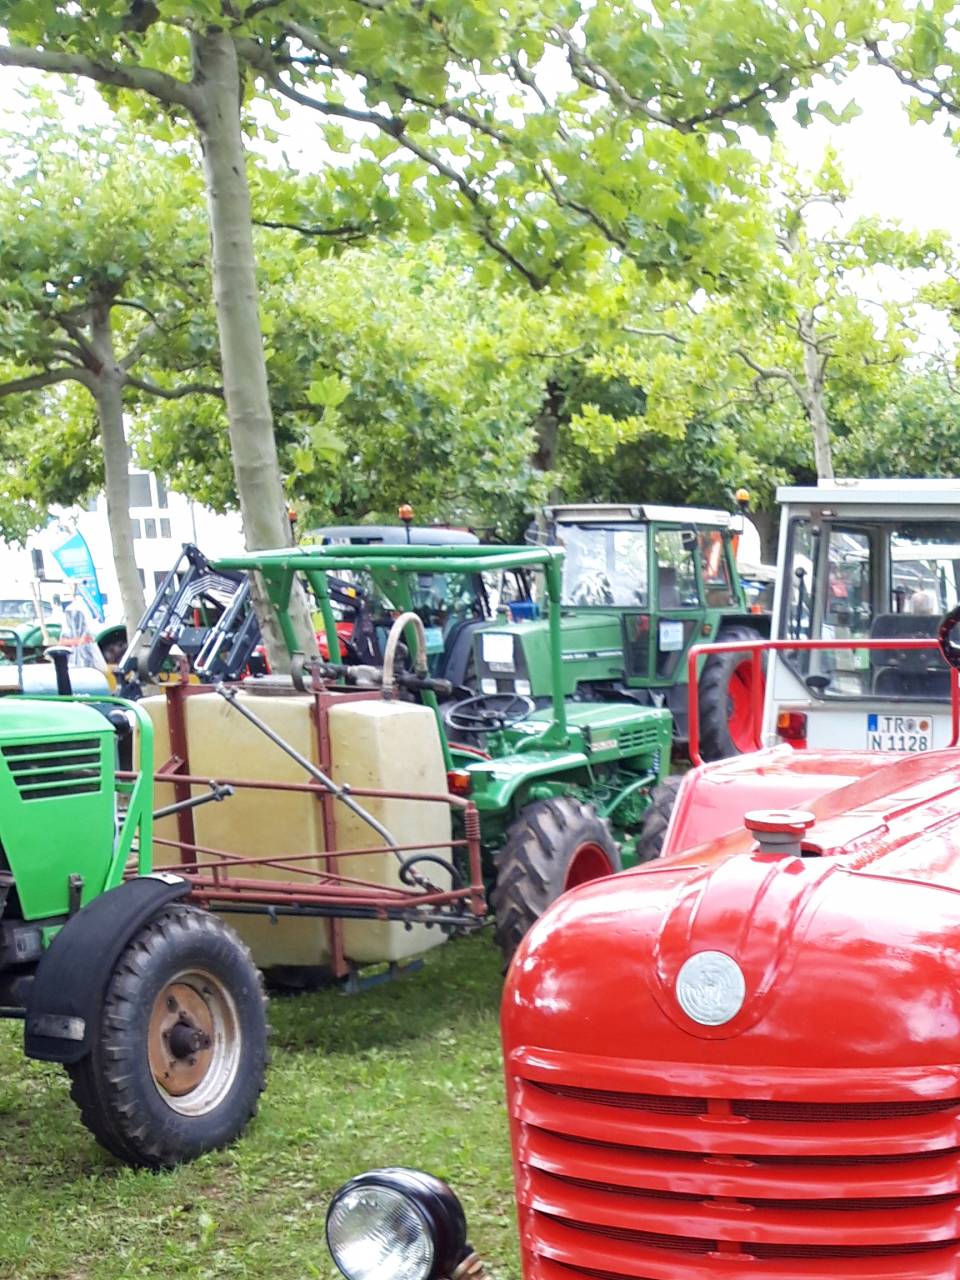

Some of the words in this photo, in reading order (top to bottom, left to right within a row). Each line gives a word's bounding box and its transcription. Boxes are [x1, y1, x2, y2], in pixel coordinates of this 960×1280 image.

[884, 717, 904, 733] TR
[872, 735, 881, 750] N
[888, 735, 928, 751] 1128
